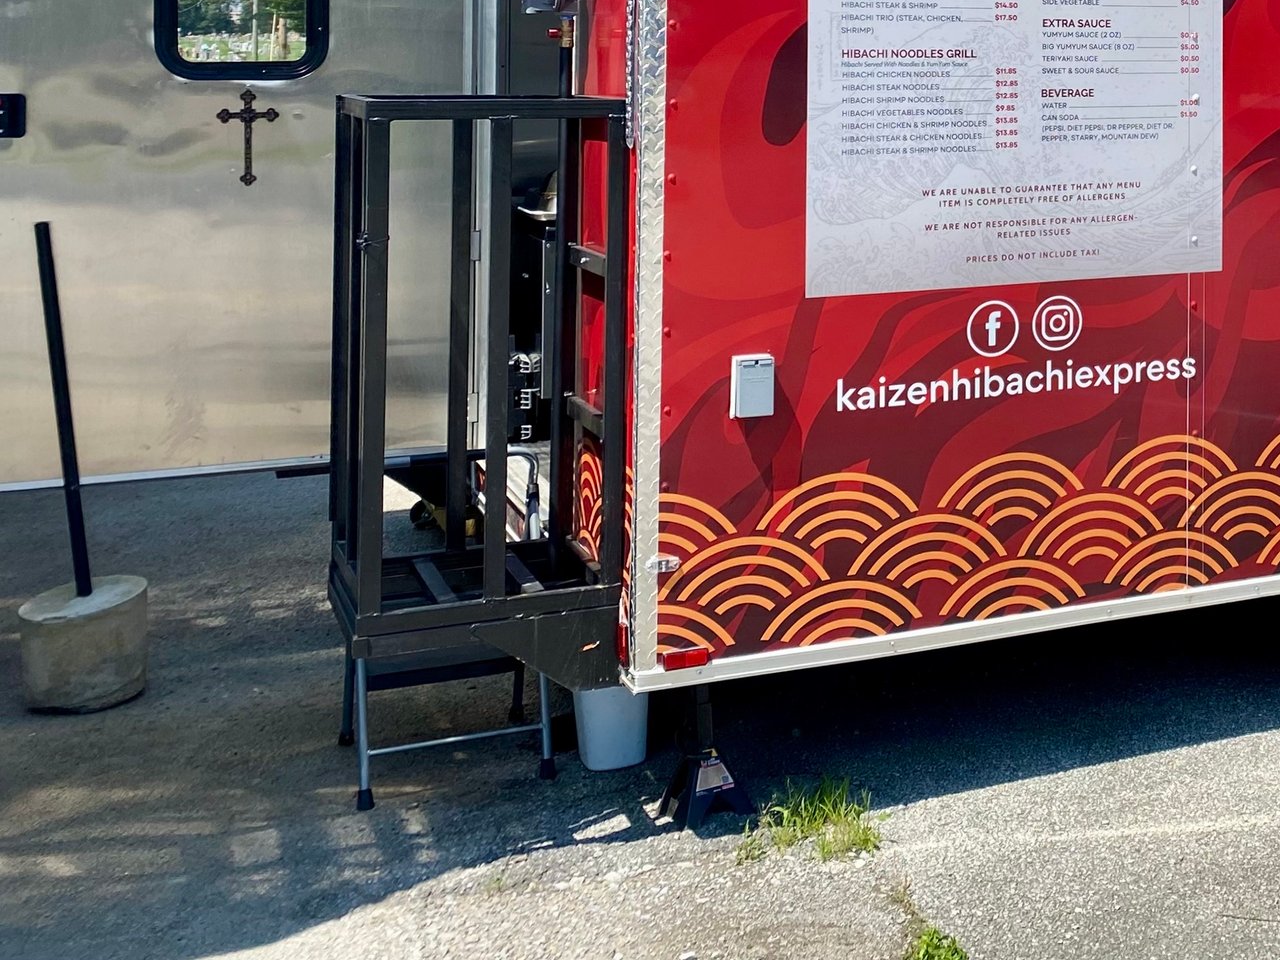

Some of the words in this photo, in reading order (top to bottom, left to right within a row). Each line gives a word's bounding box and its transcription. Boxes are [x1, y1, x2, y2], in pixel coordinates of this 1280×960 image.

[1043, 19, 1075, 28] EXTRA
[1077, 19, 1111, 28] SAUCE
[841, 26, 874, 35] SHRIMP)
[842, 50, 888, 58] HIBACHI
[890, 50, 943, 58] NOODLES
[946, 50, 977, 58] GRILL
[1041, 89, 1094, 98] BEVERAGE
[960, 187, 996, 195] UNABLE
[1014, 184, 1067, 193] GUARANTEE
[976, 197, 1034, 206] COMPLETELY
[1076, 193, 1125, 202] ALLERGENS
[985, 218, 1046, 228] RESPONSIBLE
[996, 230, 1036, 238] RELATED
[1039, 228, 1070, 237] ISSUES
[965, 255, 1000, 264] PRICES
[1039, 250, 1077, 259] INCLUDE
[836, 355, 1196, 412] kaizenhibachiexpress
